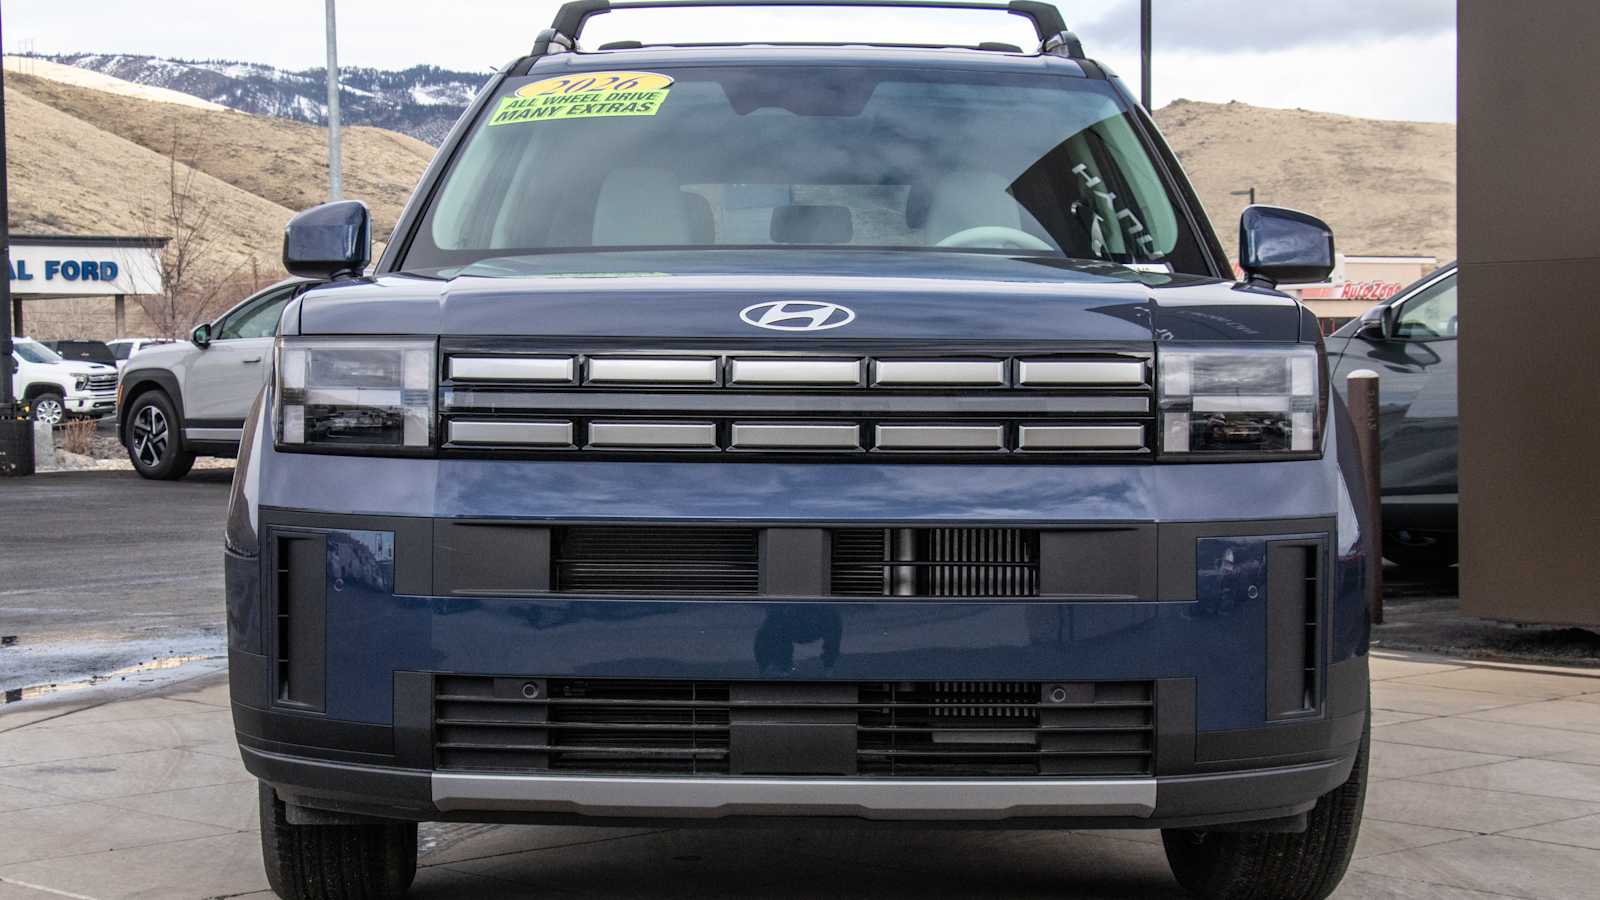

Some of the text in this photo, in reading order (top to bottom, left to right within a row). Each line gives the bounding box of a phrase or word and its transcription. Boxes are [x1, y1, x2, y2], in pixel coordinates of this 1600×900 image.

[541, 77, 639, 95] 2026
[507, 91, 660, 109] ALL WHEEL DRIVE
[495, 102, 653, 122] MANY EXTRAS
[45, 260, 118, 281] FORD
